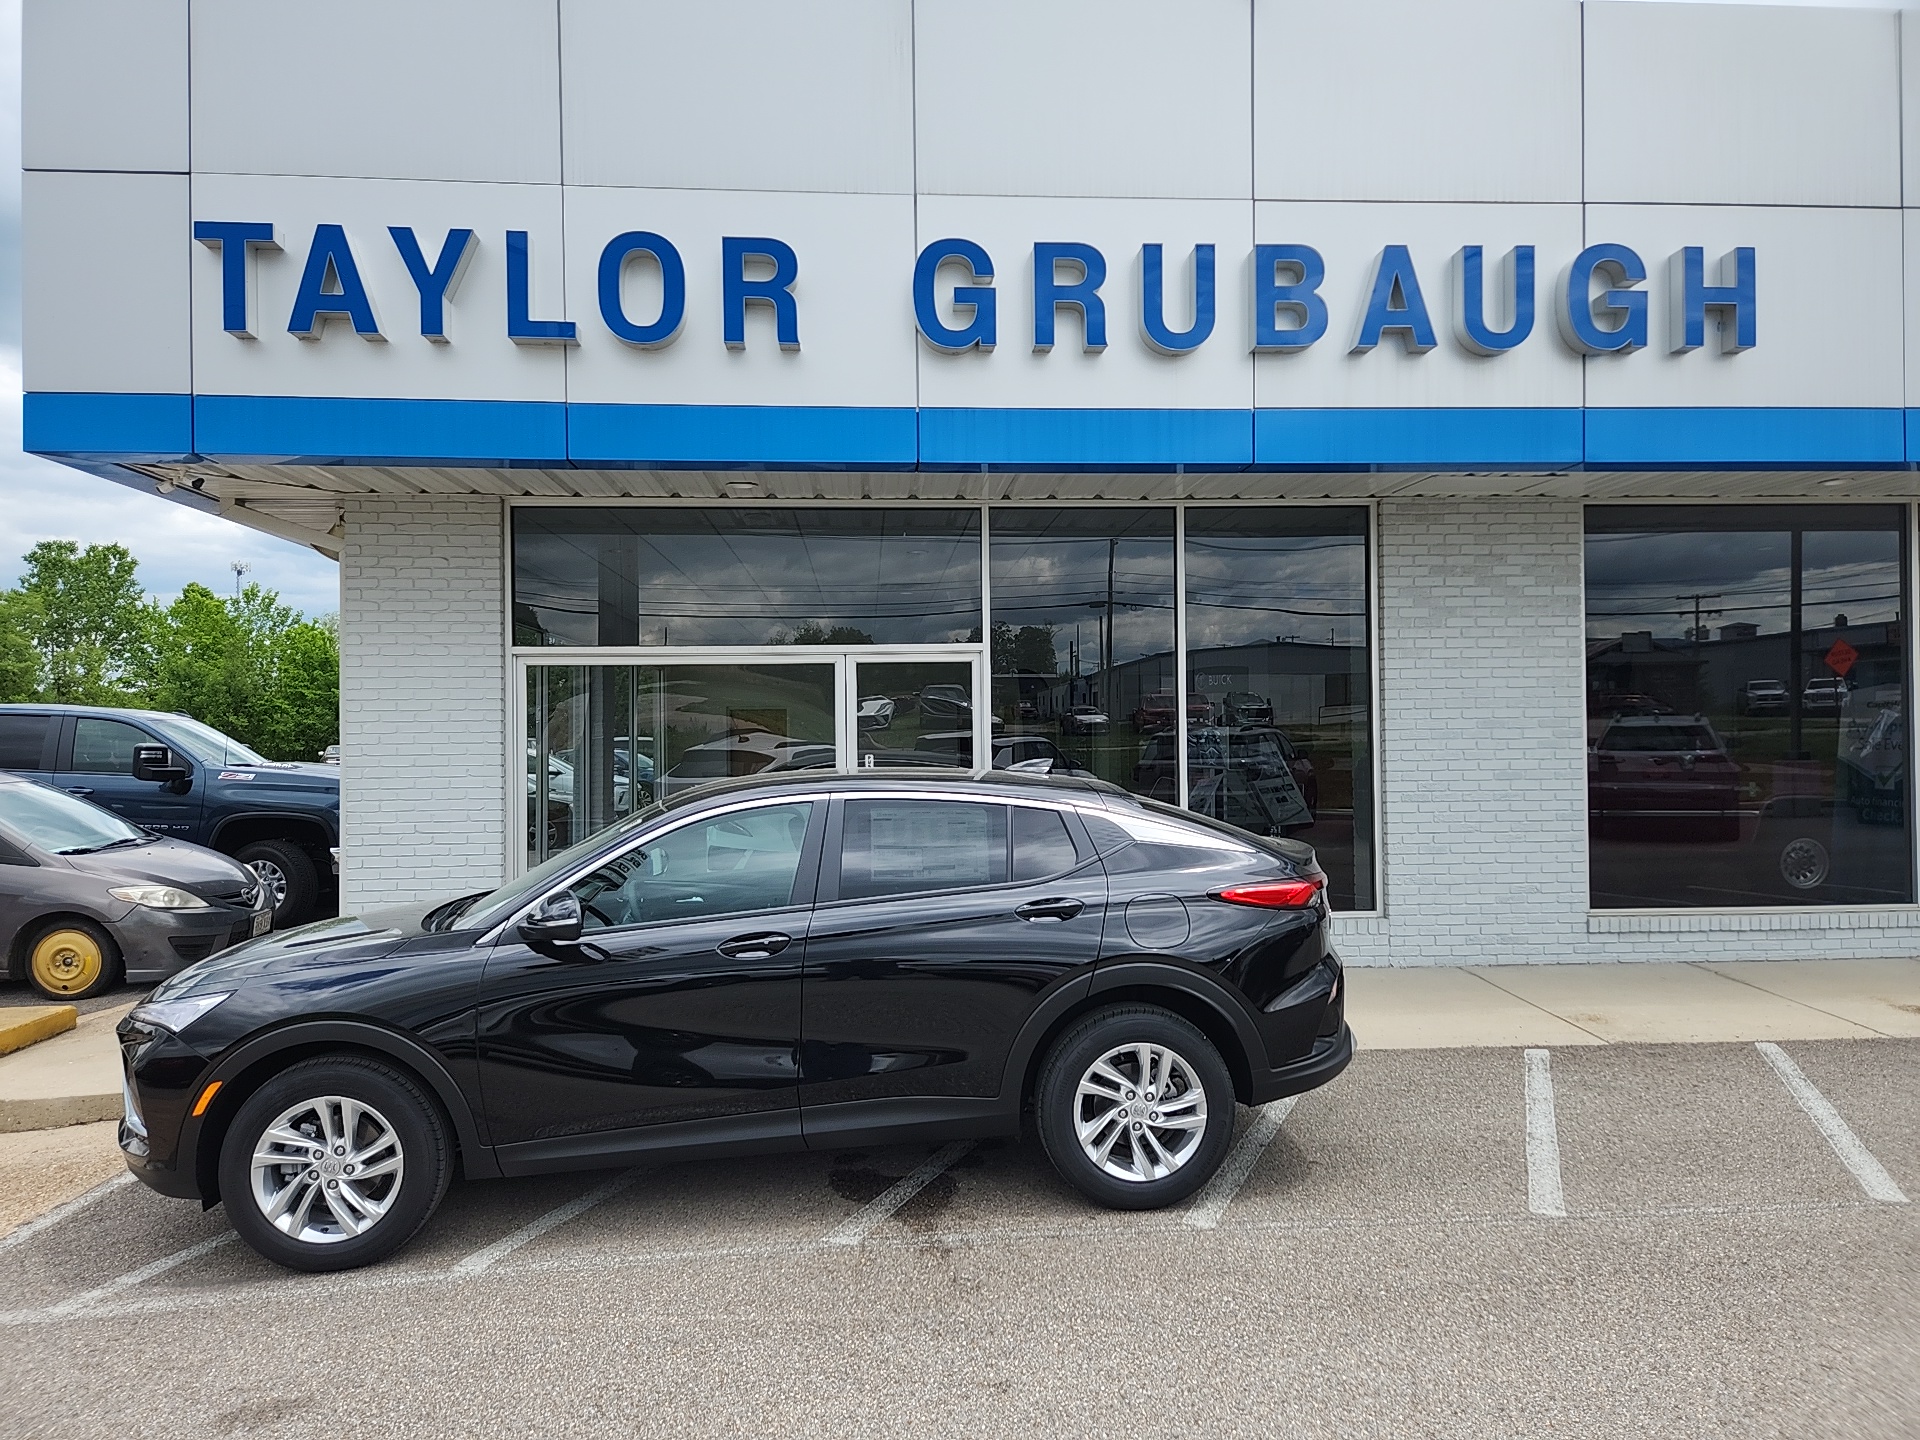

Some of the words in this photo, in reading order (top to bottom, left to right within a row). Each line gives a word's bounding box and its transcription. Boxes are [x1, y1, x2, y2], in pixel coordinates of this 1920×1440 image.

[194, 221, 801, 351] TAYLOR
[912, 237, 1757, 357] GRUBAUGH
[1208, 674, 1232, 687] BUICK
